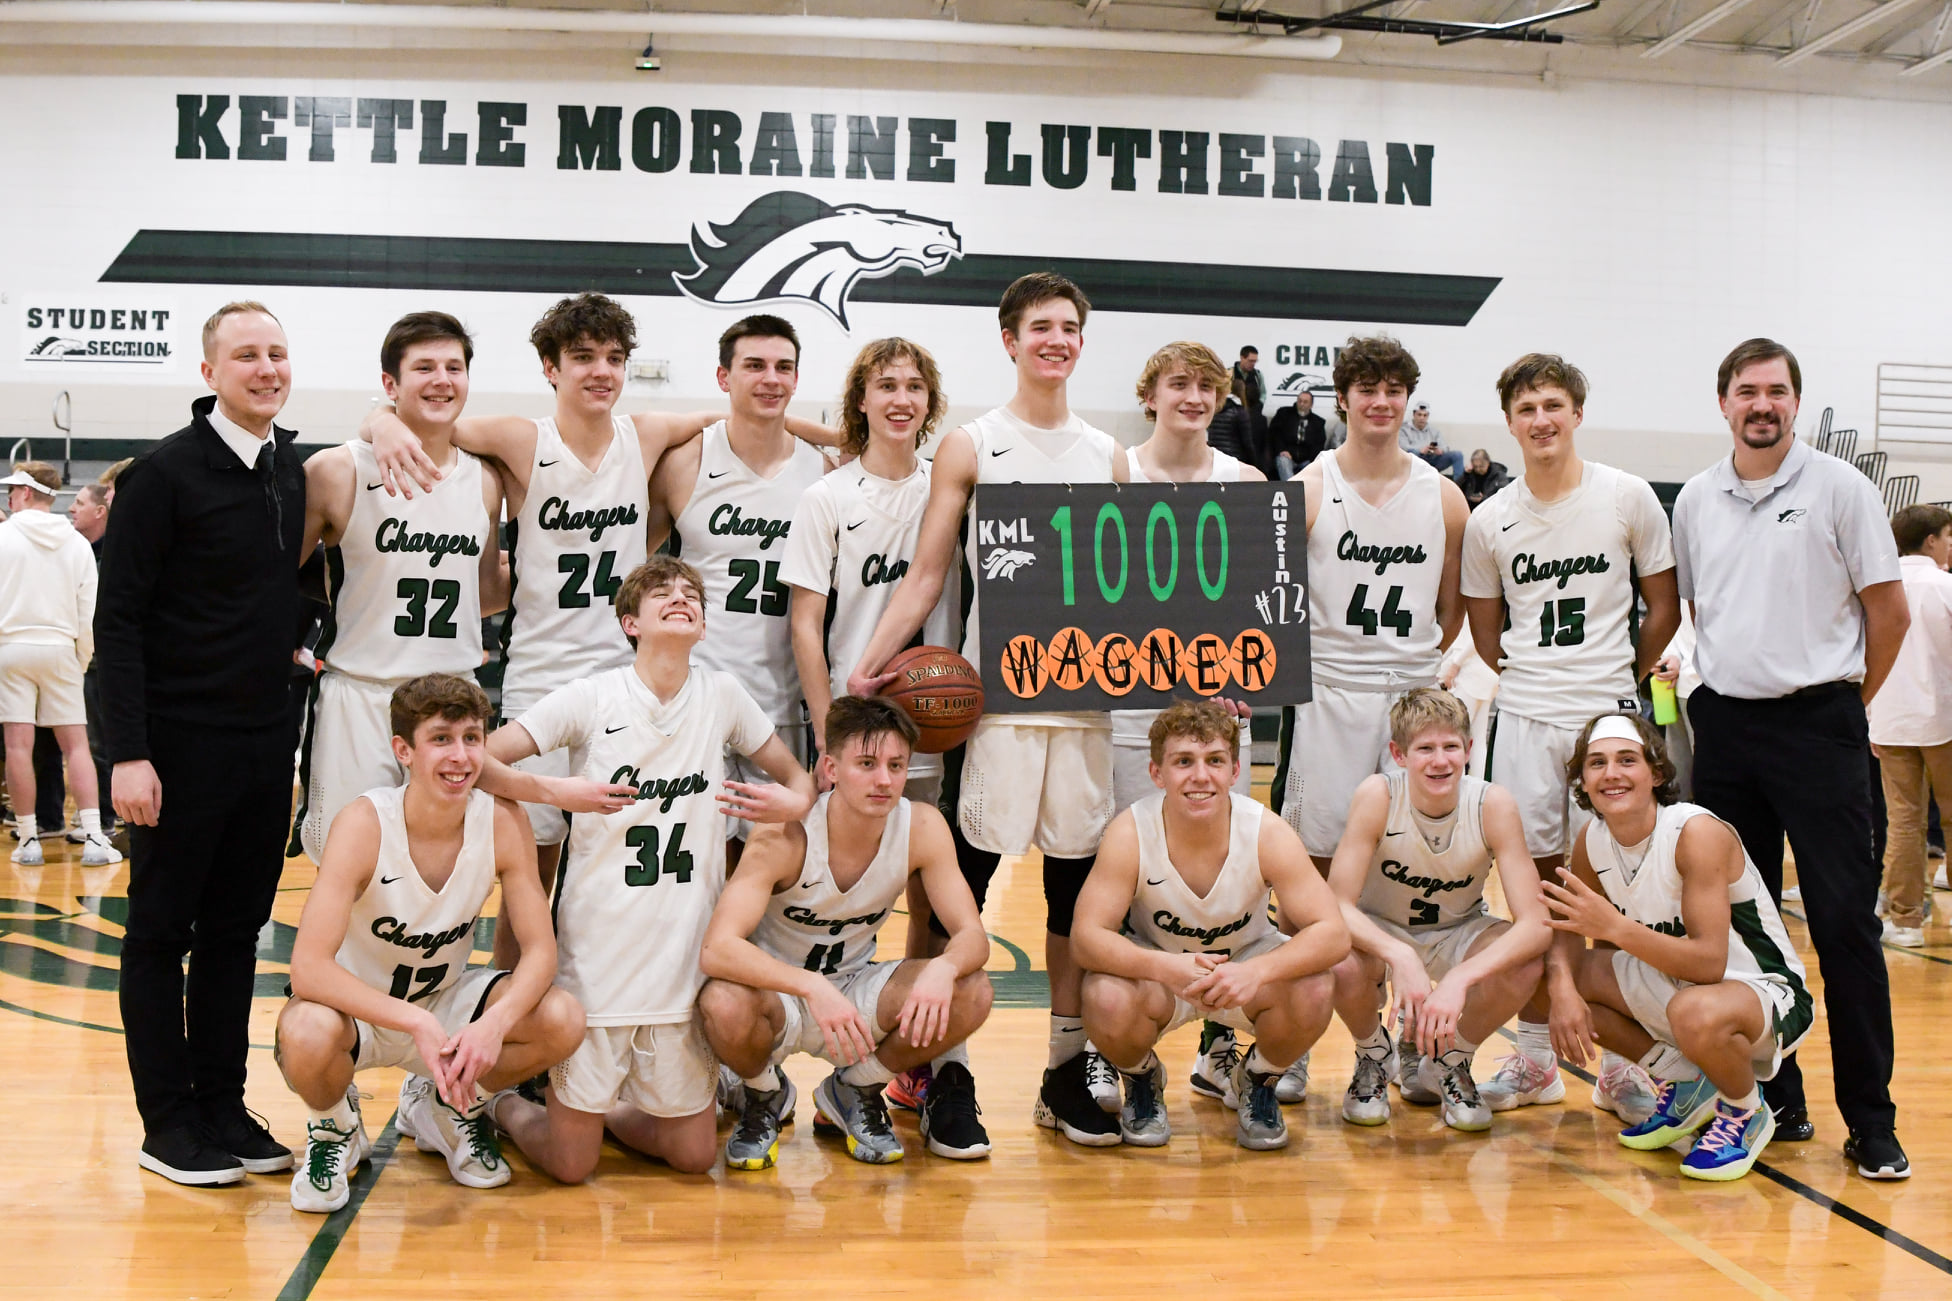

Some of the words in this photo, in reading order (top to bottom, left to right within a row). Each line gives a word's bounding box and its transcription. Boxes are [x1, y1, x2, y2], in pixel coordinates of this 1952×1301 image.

[175, 94, 528, 167] KETTLE
[556, 105, 957, 183] MORAINE
[984, 121, 1435, 207] LUTHERAN
[27, 307, 170, 331] STUDENT
[87, 340, 170, 357] SECTION
[375, 517, 480, 568] Chargers
[539, 496, 639, 543] Chargers
[978, 517, 1035, 546] KML
[1271, 491, 1290, 584] Austin
[1050, 500, 1229, 606] 1000
[1337, 530, 1427, 576] Chargers
[1511, 552, 1610, 590] Chargers
[557, 550, 623, 609] 24
[725, 558, 790, 617] 25
[394, 577, 461, 639] 32
[1254, 583, 1306, 625] #23
[1346, 583, 1413, 638] 44
[1537, 597, 1586, 647] 15
[906, 664, 977, 687] SPALDING
[1005, 629, 1267, 695] WAGNER
[912, 695, 978, 711] TF-1000
[624, 822, 694, 887] 34
[1381, 860, 1475, 898] Chargers
[1408, 898, 1440, 926] 3
[388, 963, 450, 1003] 12
